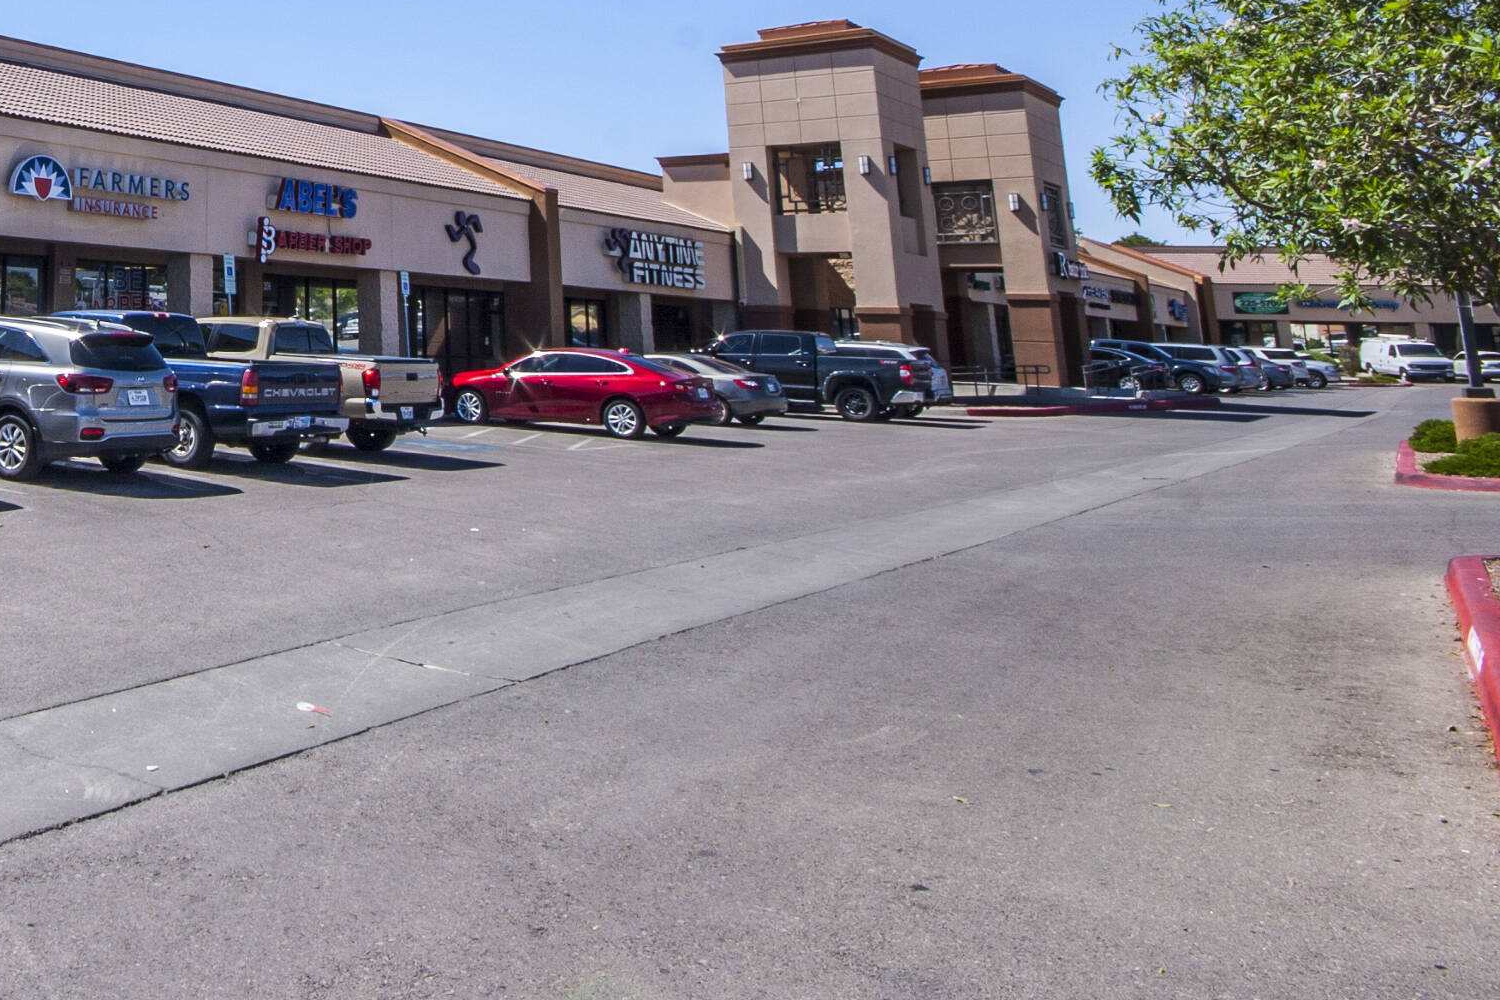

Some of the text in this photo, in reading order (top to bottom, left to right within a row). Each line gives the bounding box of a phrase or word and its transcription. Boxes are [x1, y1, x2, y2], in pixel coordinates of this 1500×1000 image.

[76, 167, 190, 201] FARMERS
[76, 198, 158, 220] INSURANCE
[276, 178, 358, 219] ABEL'S
[330, 235, 372, 255] SHOP
[629, 231, 705, 266] ANYTIME
[633, 261, 706, 289] FITNESS
[264, 386, 337, 397] CHEVROLET
